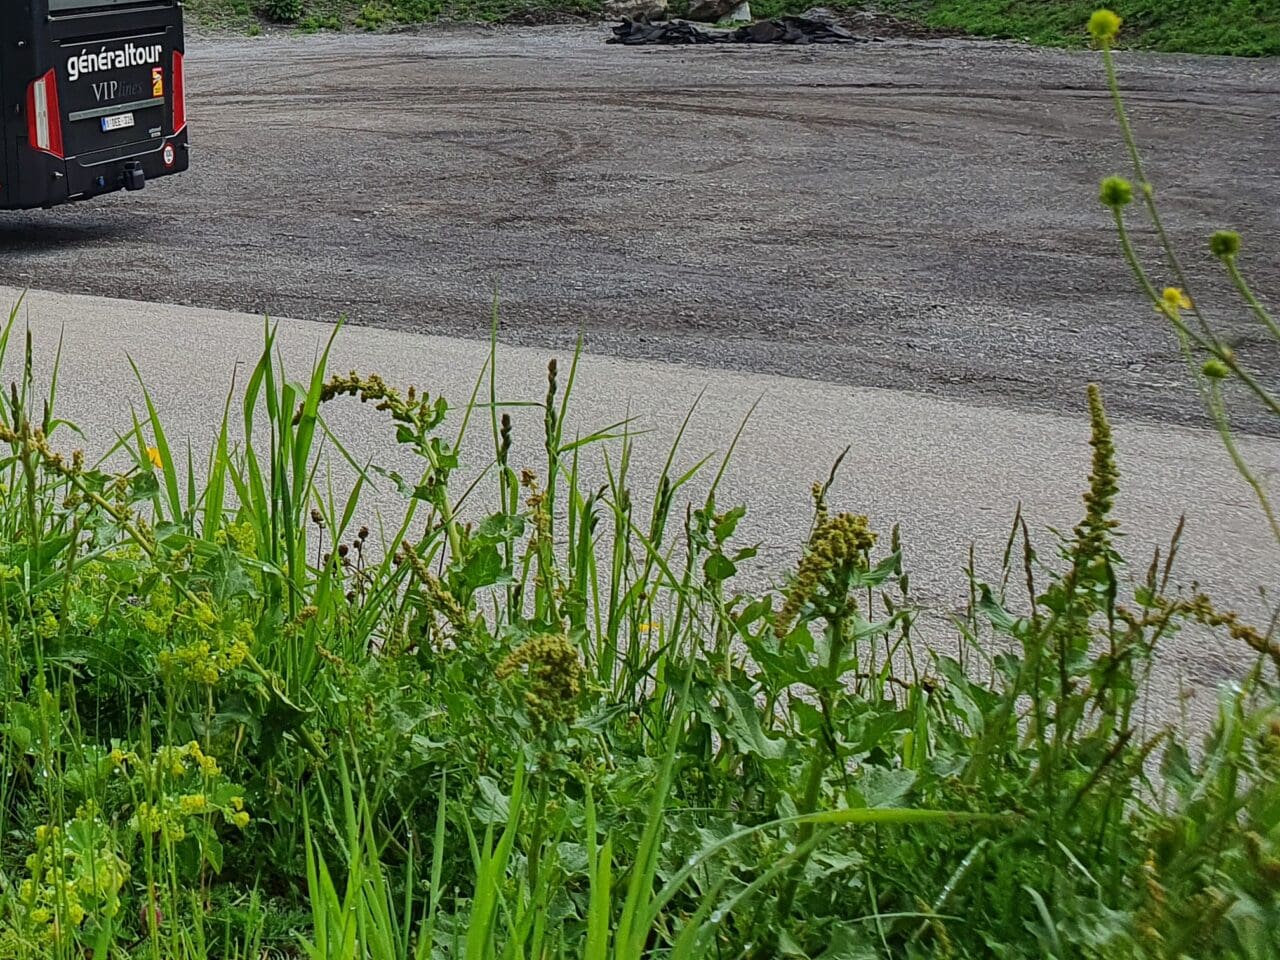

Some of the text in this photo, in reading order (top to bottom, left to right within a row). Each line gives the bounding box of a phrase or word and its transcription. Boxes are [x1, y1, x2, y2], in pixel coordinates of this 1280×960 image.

[67, 42, 163, 81] généraltour
[92, 80, 144, 102] VIP lines
